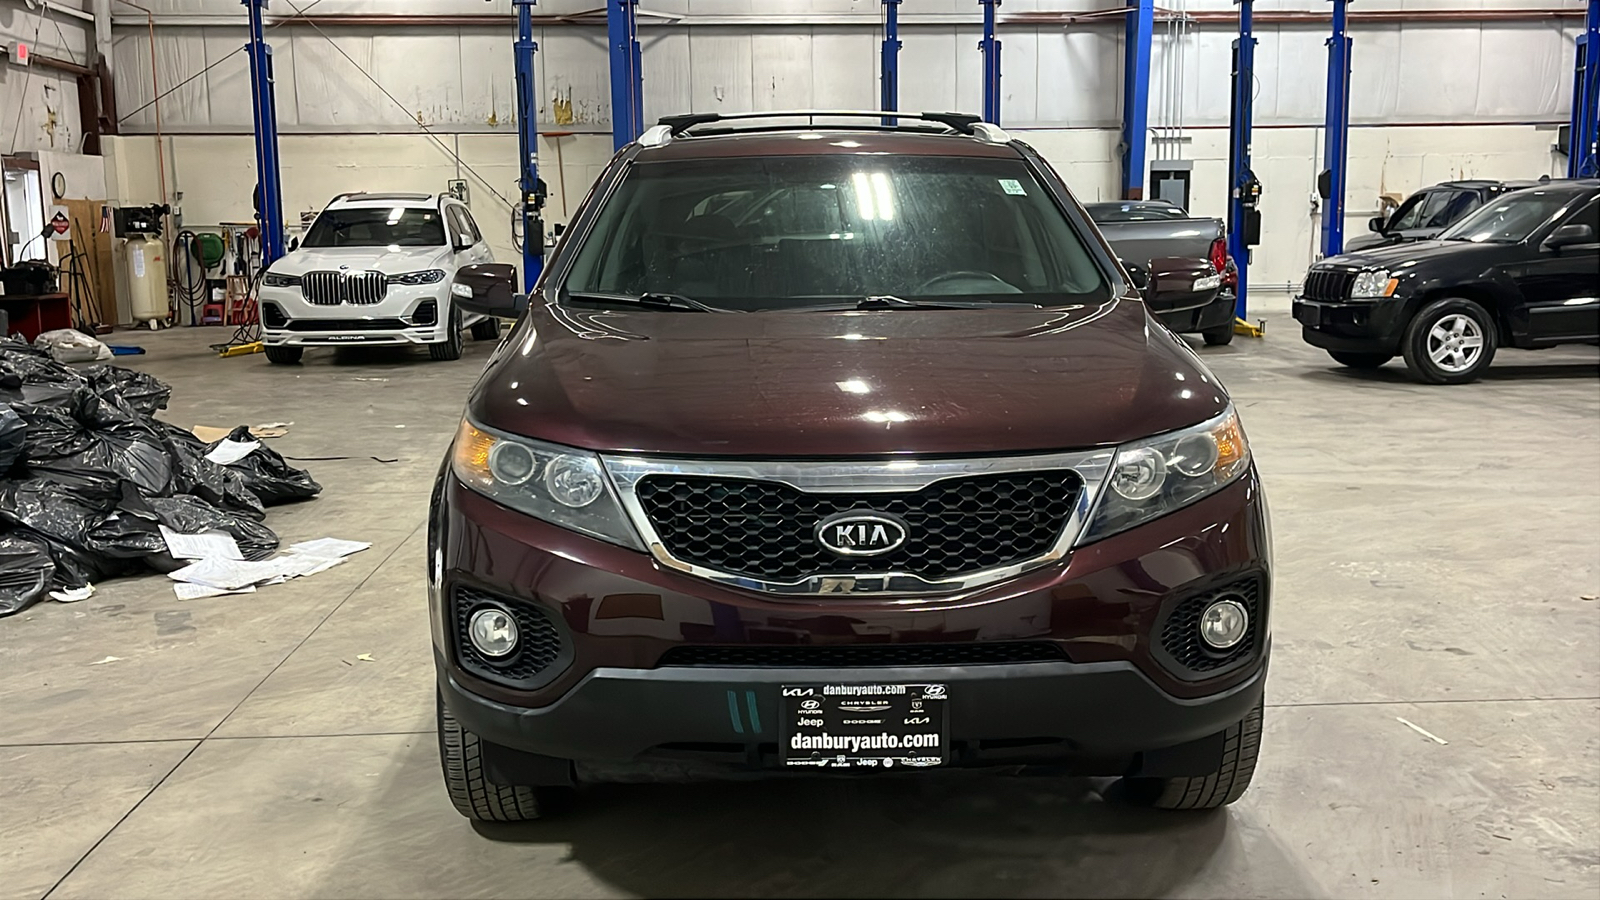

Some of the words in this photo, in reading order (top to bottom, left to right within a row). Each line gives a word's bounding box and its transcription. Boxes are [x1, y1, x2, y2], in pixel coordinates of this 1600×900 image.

[836, 524, 890, 546] KIA
[823, 684, 906, 697] danburyauto.com
[797, 717, 824, 728] Jeep
[791, 732, 940, 753] danburyauto.com
[856, 757, 878, 768] Jeep
